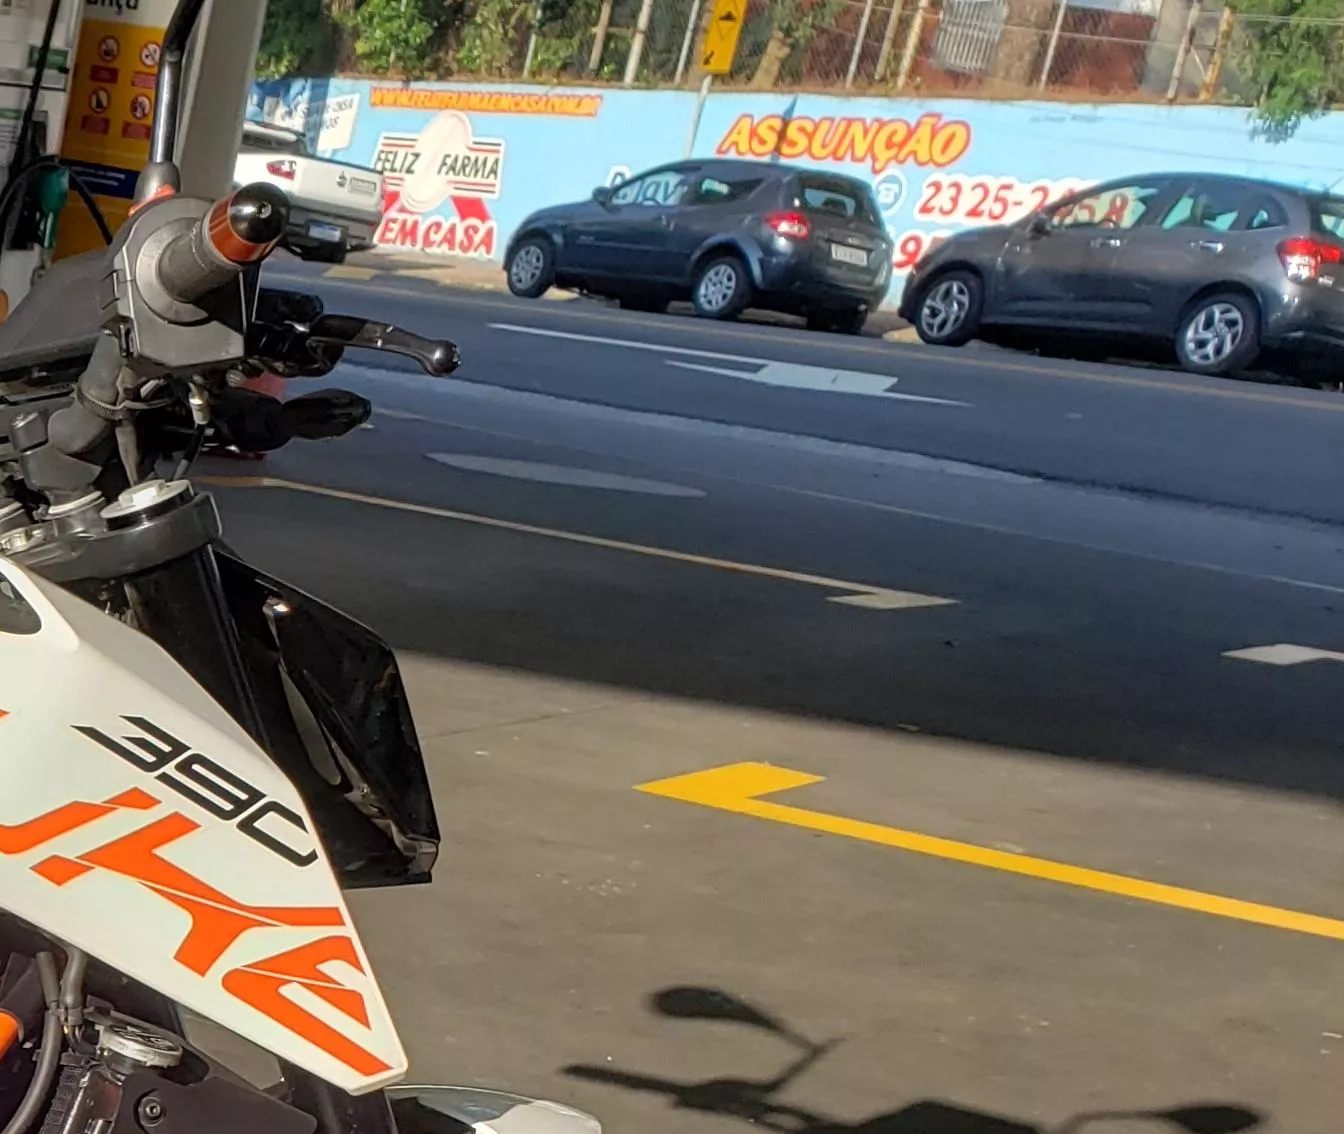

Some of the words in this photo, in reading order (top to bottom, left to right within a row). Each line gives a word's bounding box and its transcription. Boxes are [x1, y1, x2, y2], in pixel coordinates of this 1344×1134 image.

[374, 150, 420, 175] FELIZ
[436, 153, 500, 180] FARMA
[717, 113, 972, 174] ASSUNÇÃO
[378, 217, 419, 246] EM
[422, 221, 495, 256] CASA
[71, 714, 320, 868] 390
